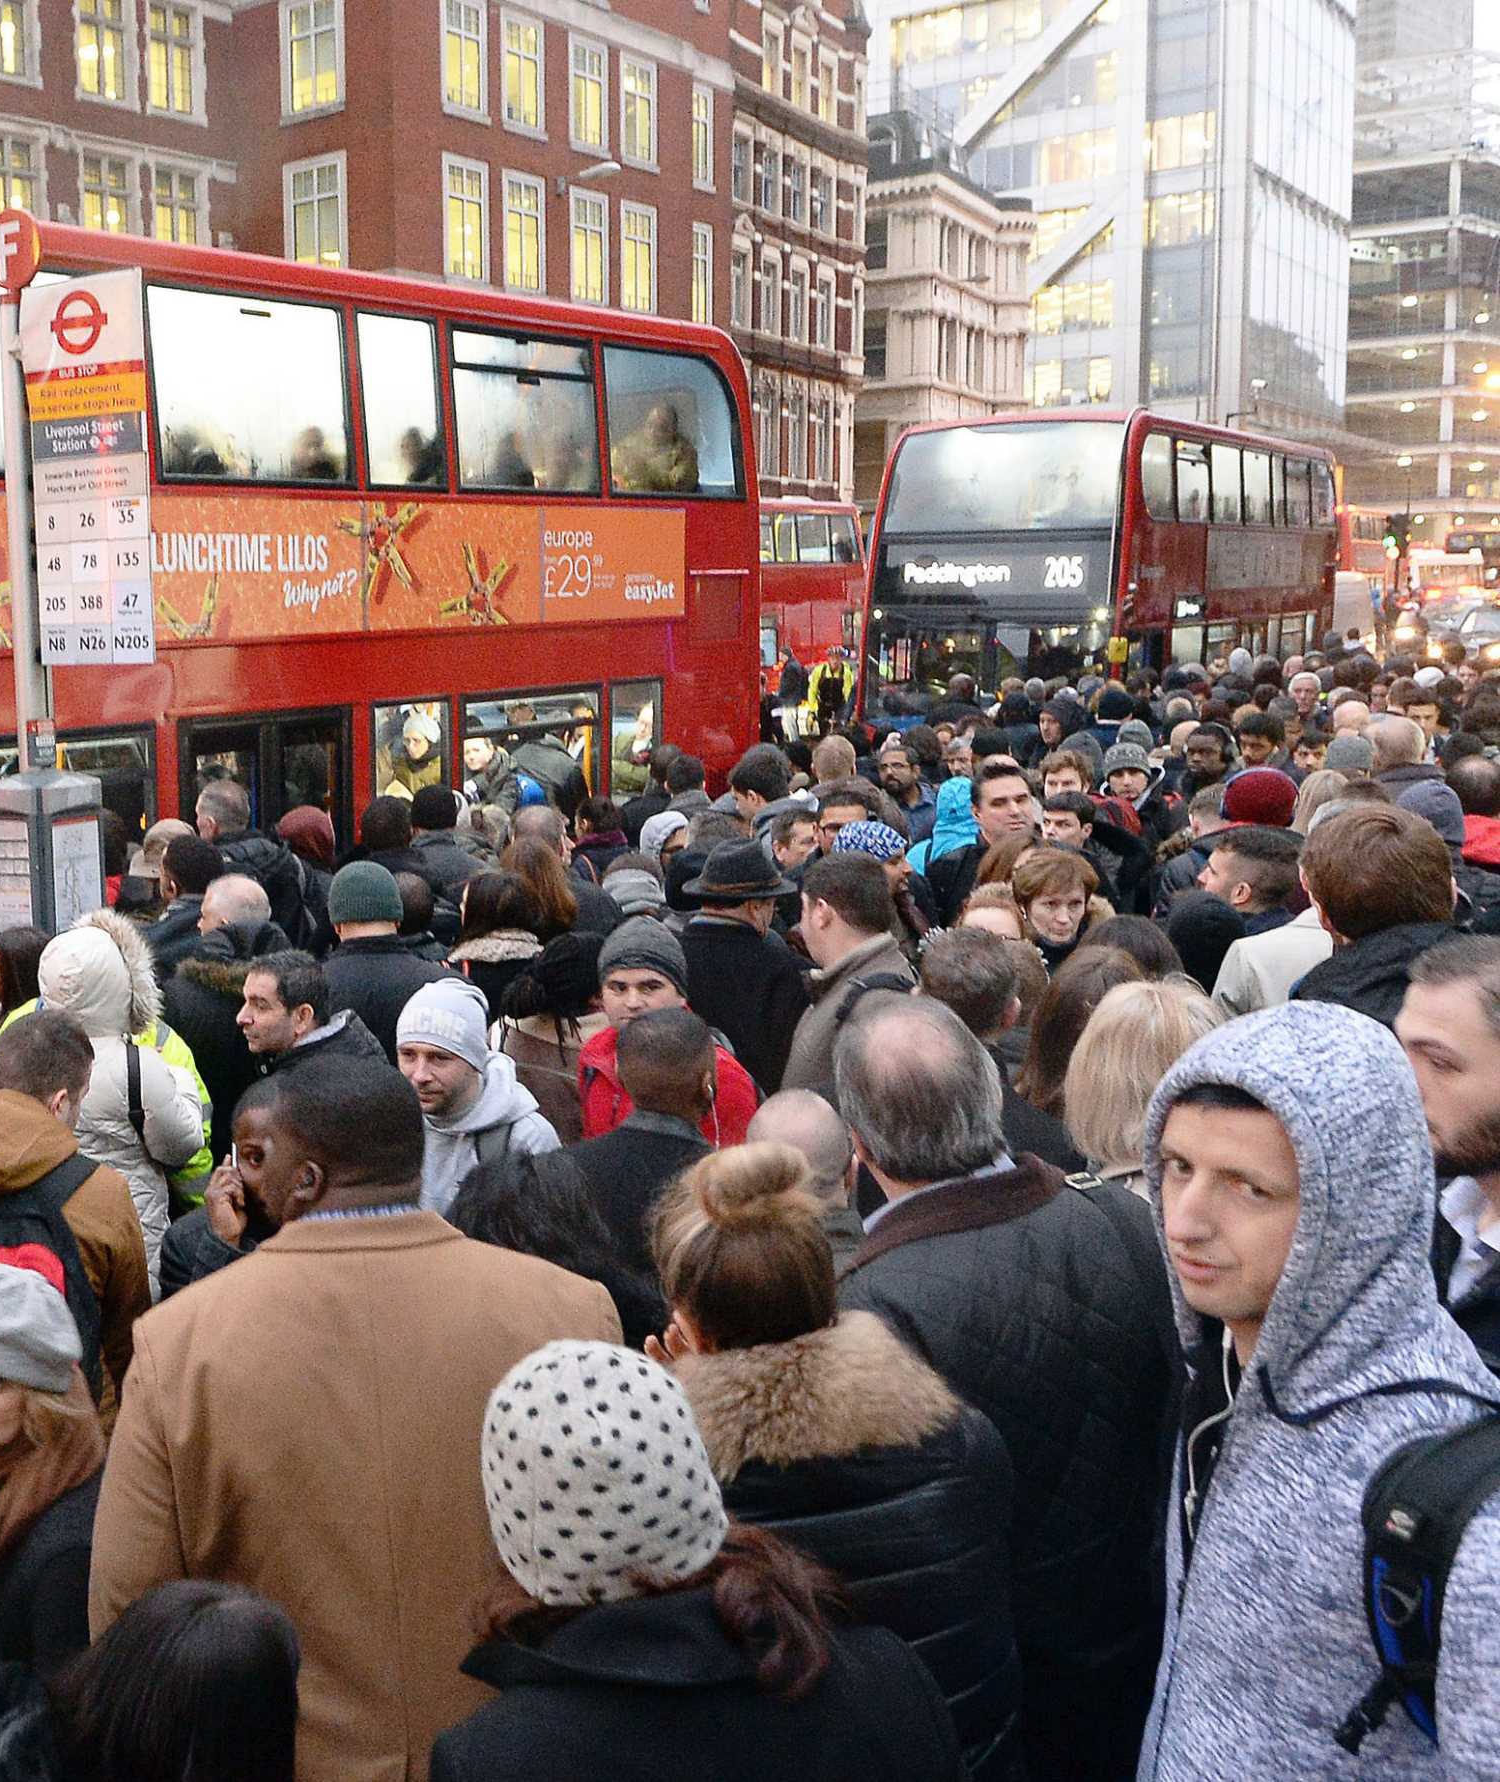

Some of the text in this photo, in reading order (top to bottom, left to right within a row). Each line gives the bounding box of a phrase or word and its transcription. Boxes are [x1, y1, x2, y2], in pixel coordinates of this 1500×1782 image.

[44, 419, 125, 440] Liverpool Street
[52, 438, 88, 453] Station
[47, 509, 135, 530] 8 26 35
[543, 529, 594, 551] europe
[47, 551, 140, 572] 48 78 135
[150, 531, 329, 573] LUNCHTIME LILOS
[903, 555, 1085, 588] Paddington 205
[282, 567, 358, 614] Why not?
[624, 580, 676, 605] easyJet
[45, 593, 139, 612] 205 388 47
[48, 634, 150, 652] N8 N26 N205
